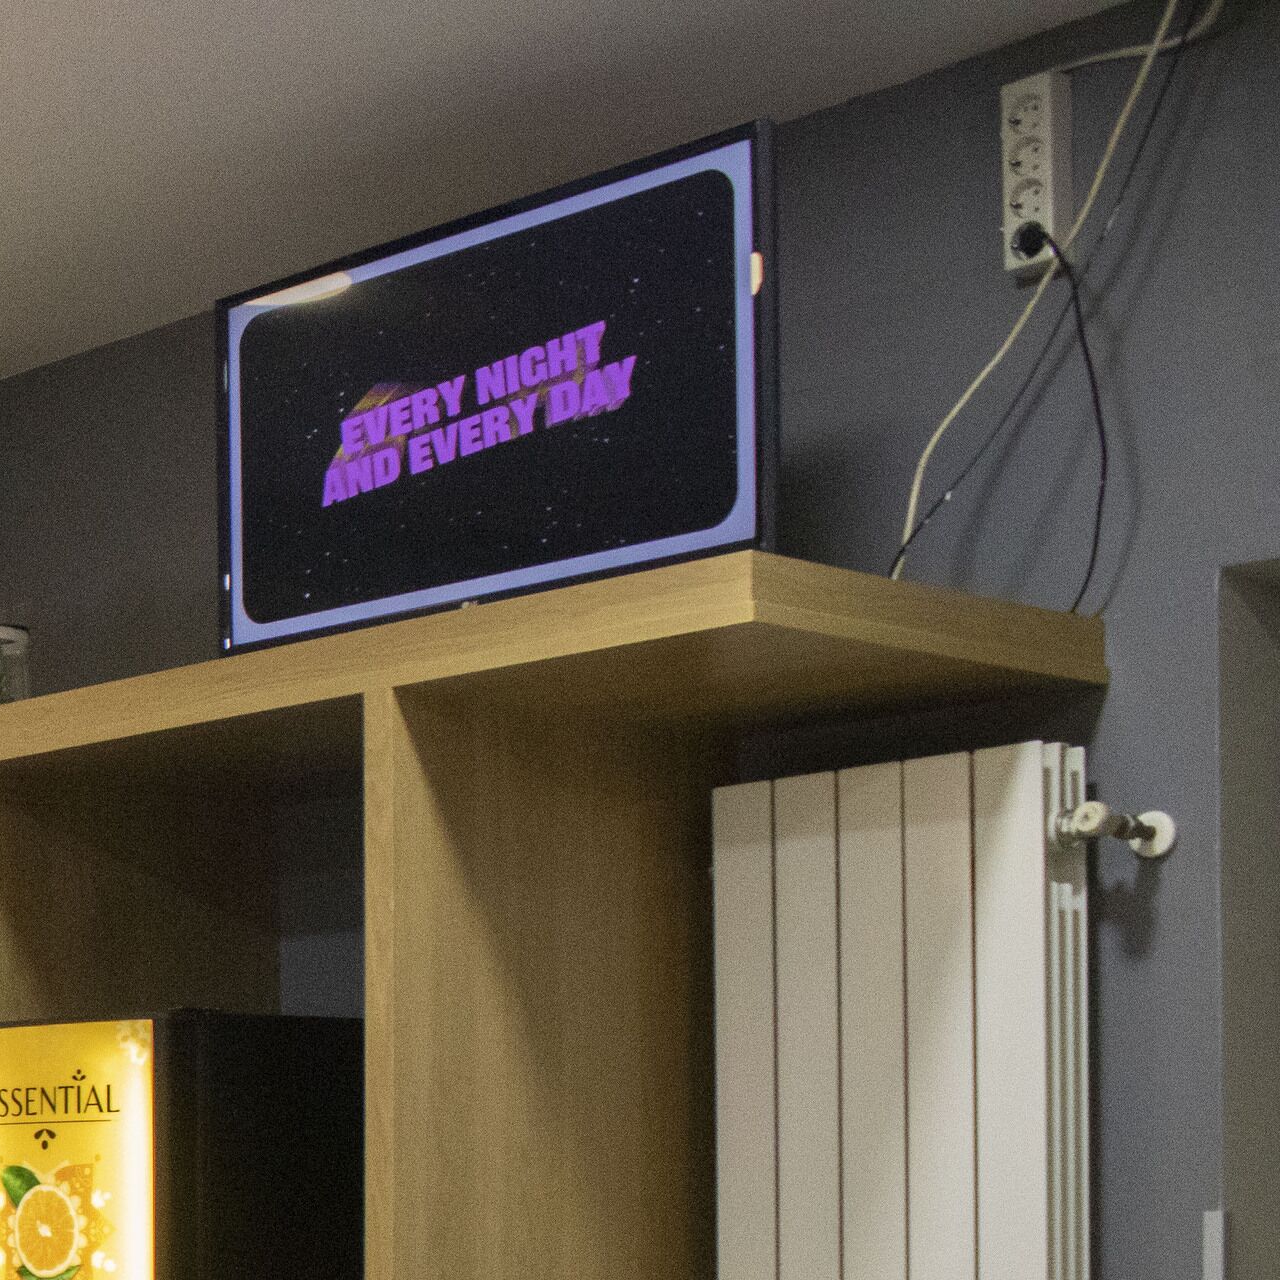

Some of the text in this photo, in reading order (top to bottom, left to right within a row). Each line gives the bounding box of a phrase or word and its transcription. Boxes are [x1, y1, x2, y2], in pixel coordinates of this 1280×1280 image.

[322, 354, 638, 508] AND EVERY DAY
[340, 320, 607, 455] EVERY NIGHT
